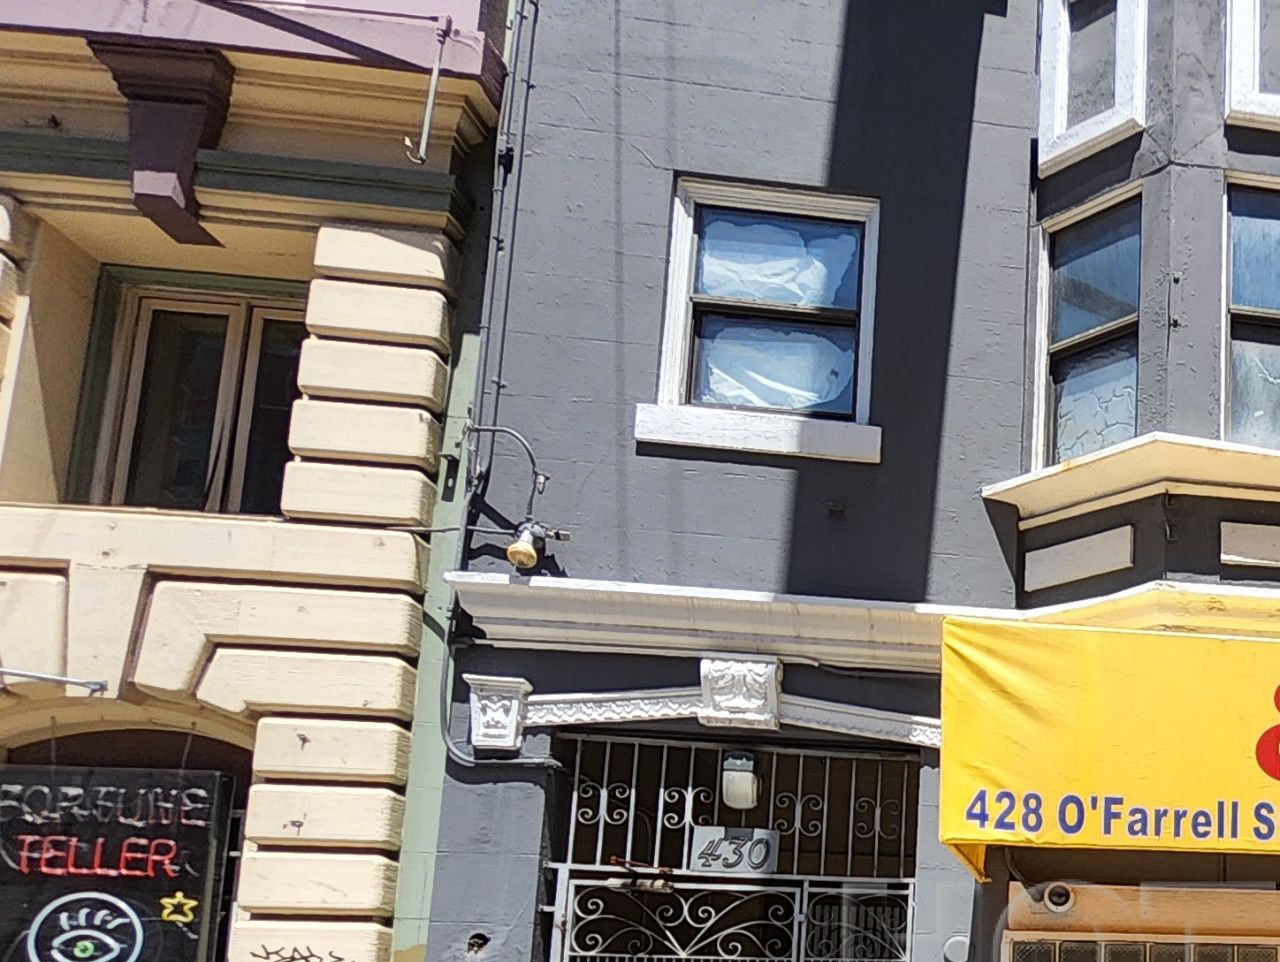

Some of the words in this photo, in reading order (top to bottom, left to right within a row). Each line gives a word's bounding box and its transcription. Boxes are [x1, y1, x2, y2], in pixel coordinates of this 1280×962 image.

[965, 789, 1044, 833] 428
[1057, 794, 1240, 840] O'Farrell
[17, 834, 180, 878] TELLER
[697, 837, 771, 871] 430
